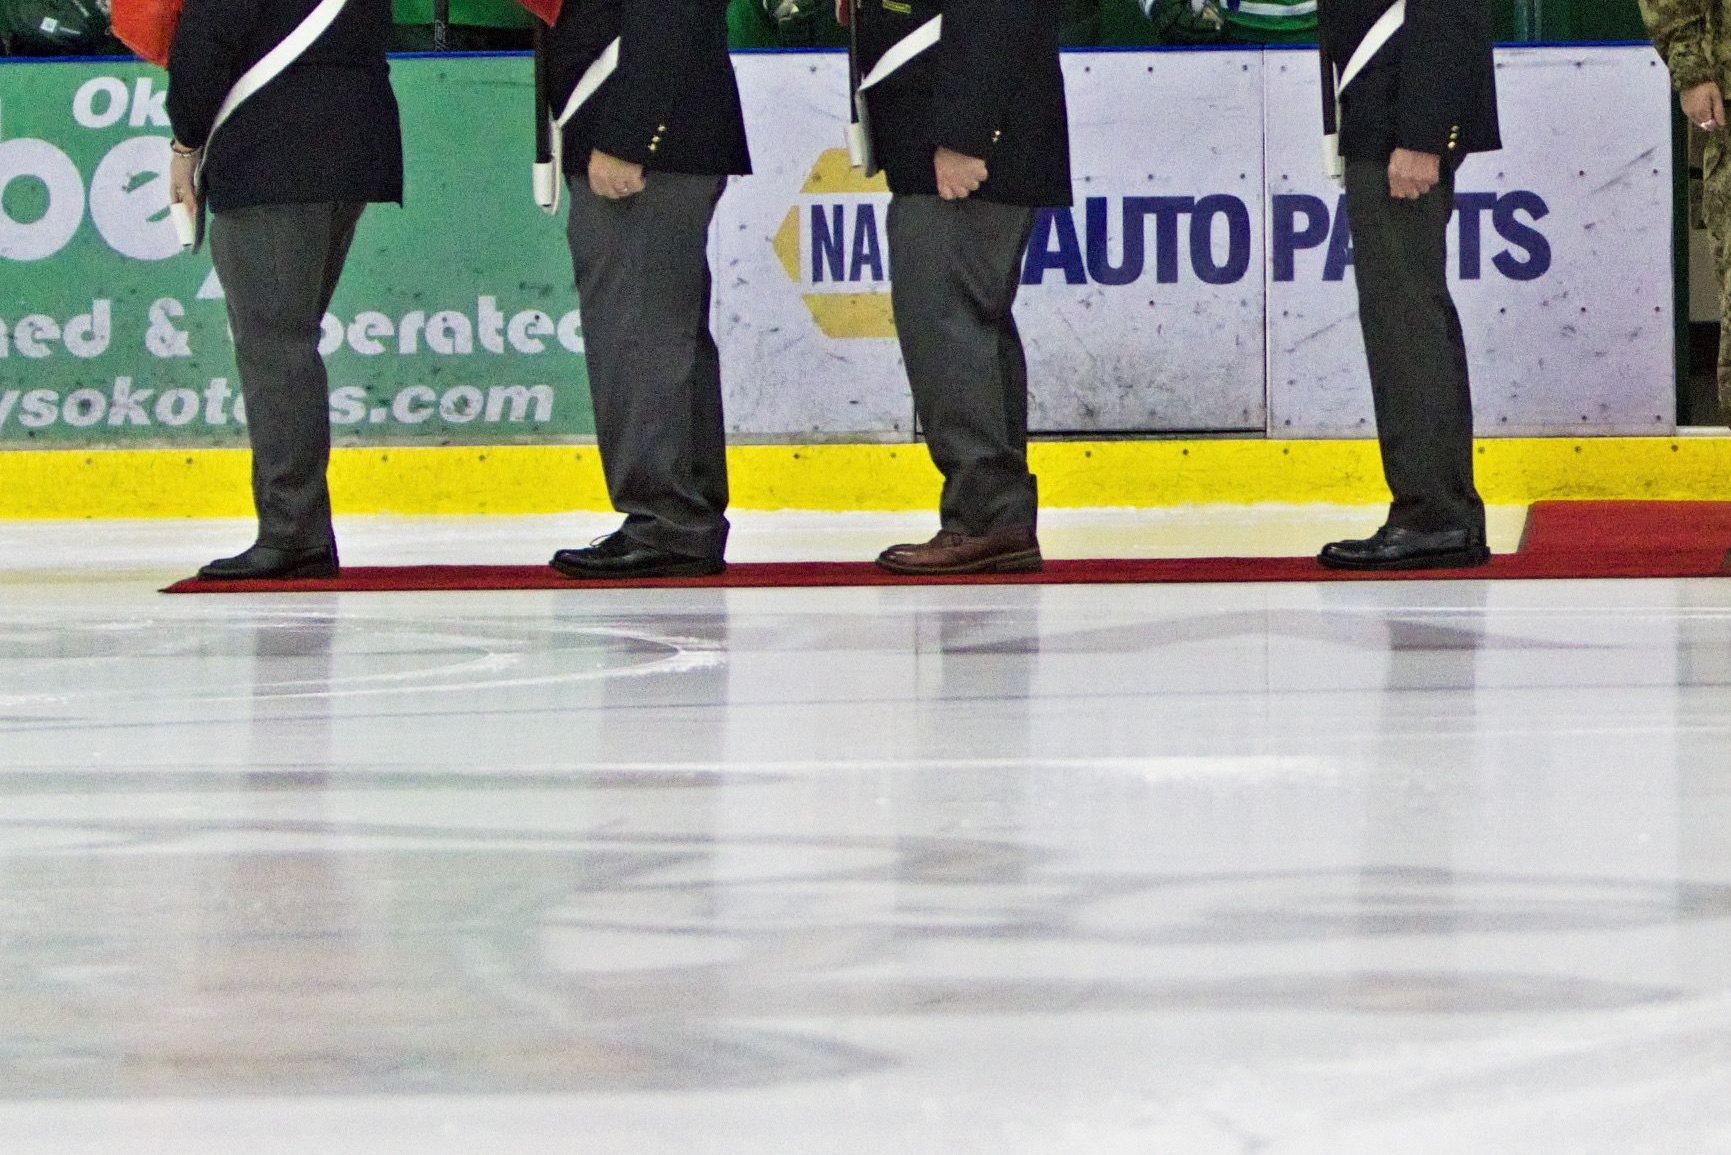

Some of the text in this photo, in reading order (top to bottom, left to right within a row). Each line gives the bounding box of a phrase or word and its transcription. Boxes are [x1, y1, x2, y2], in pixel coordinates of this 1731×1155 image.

[810, 190, 1551, 286] NA AUTO PTS
[145, 298, 193, 357] &
[0, 376, 555, 424] sokots.com
